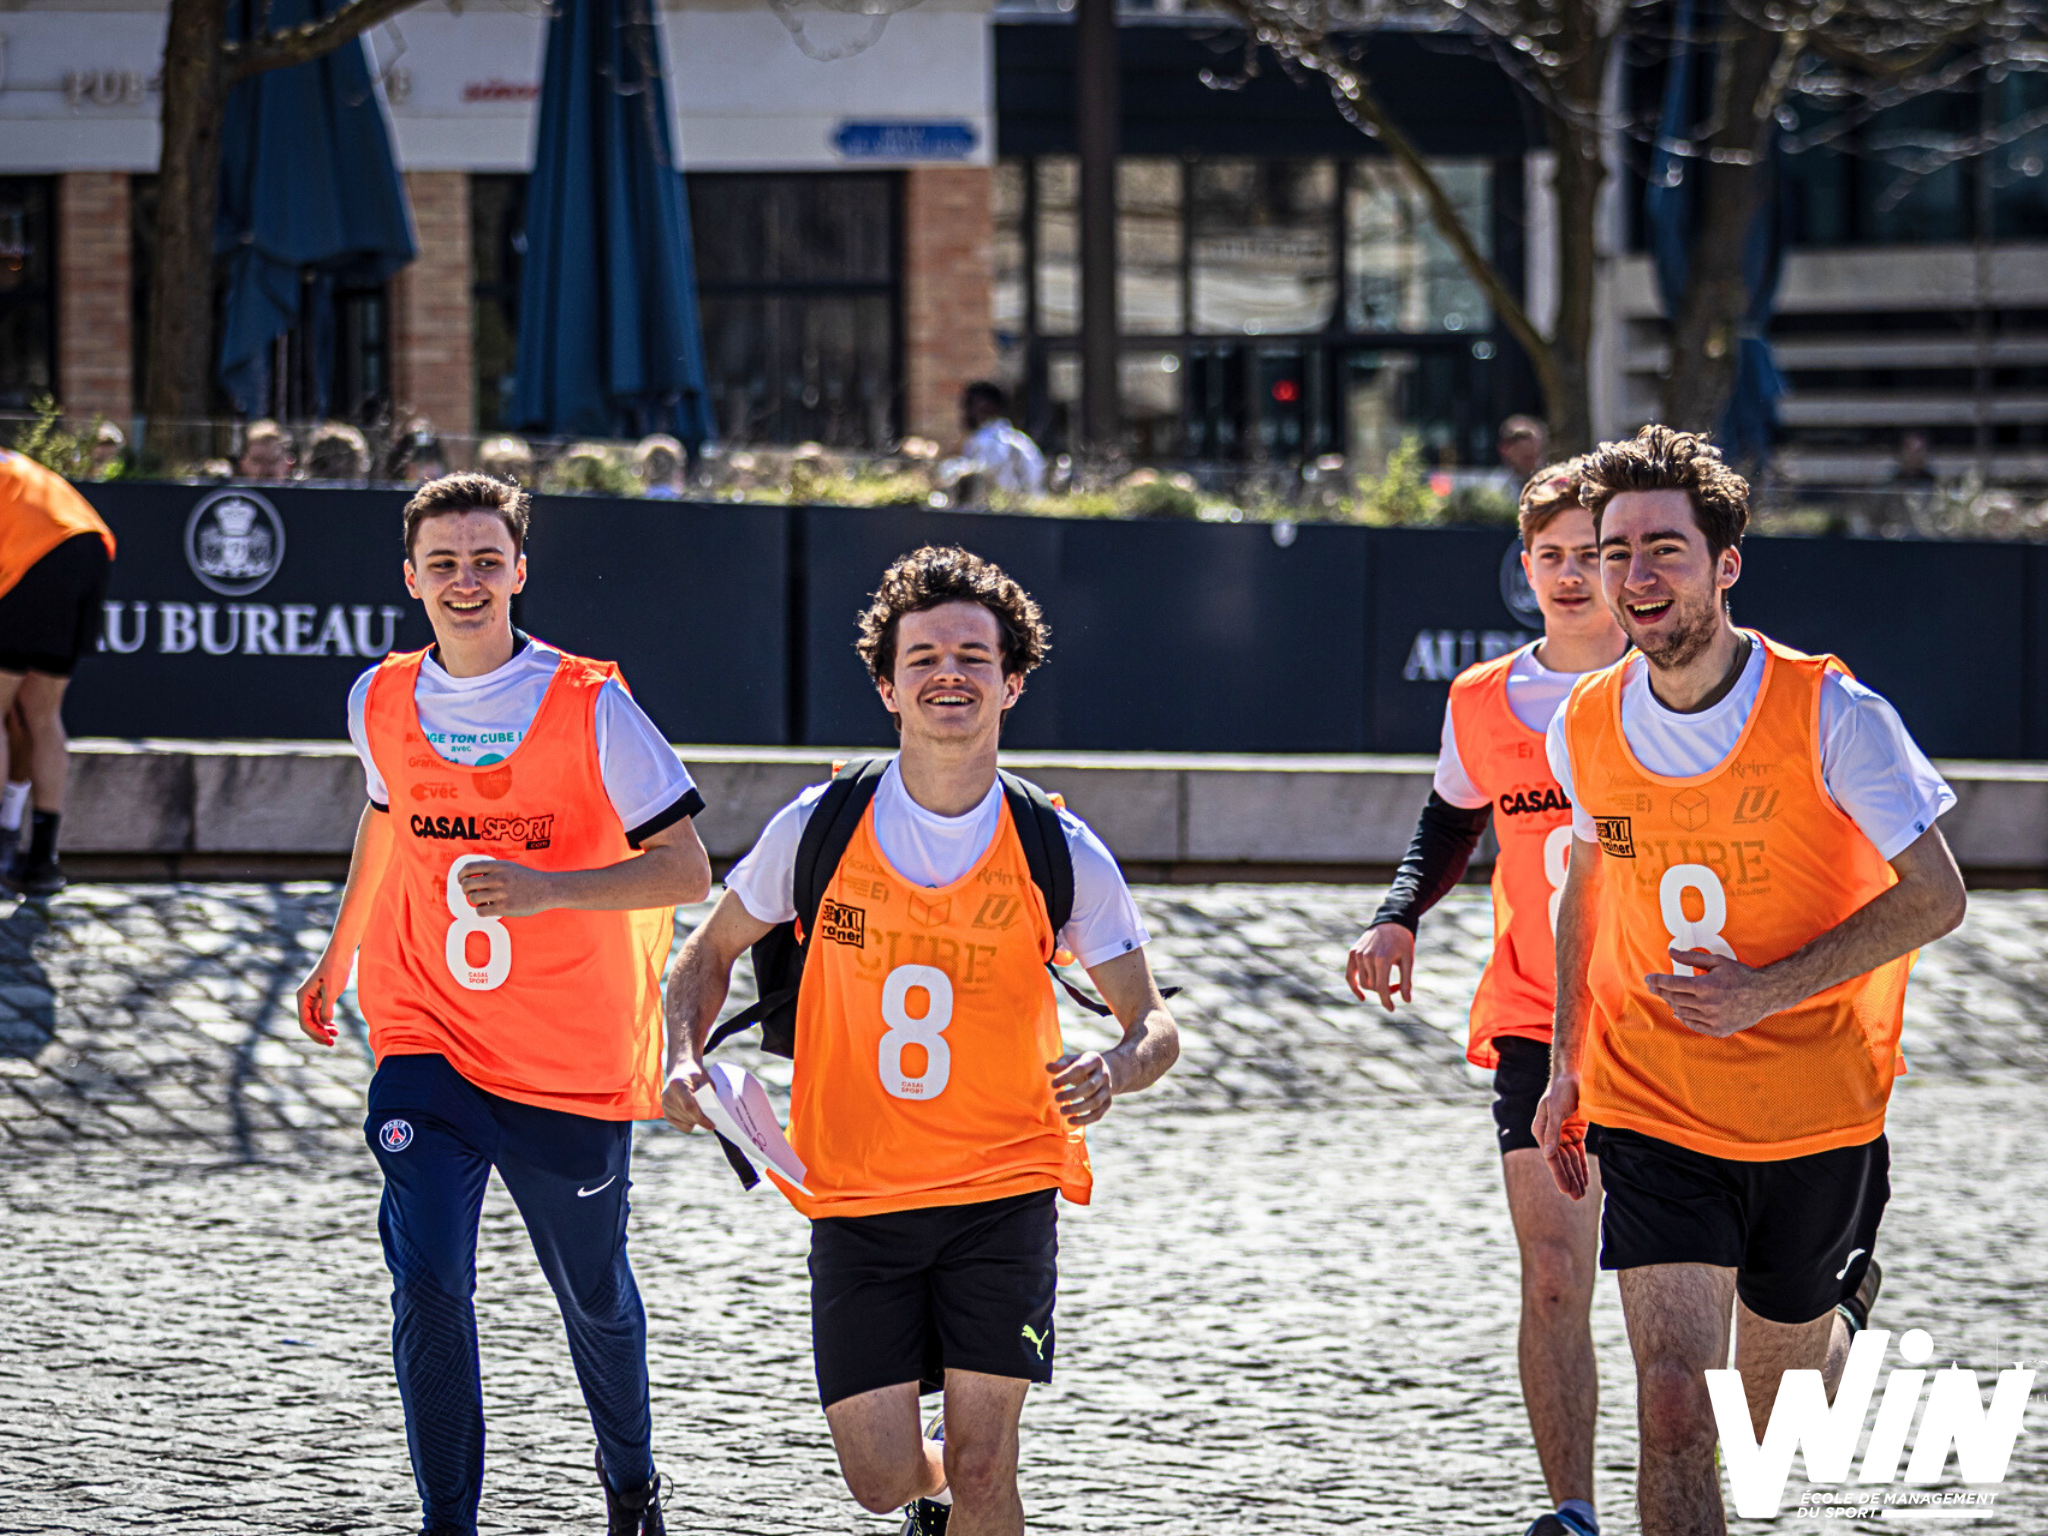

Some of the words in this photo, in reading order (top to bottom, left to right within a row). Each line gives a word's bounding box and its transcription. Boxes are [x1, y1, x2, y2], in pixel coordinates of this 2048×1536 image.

[97, 601, 149, 653] U
[158, 602, 397, 657] BUREAU
[451, 734, 477, 744] TON
[480, 732, 515, 744] CUBE
[1607, 820, 1629, 842] XL
[446, 854, 512, 991] 8
[837, 907, 861, 932] XL
[1660, 864, 1740, 978] 8
[878, 964, 954, 1101] 8
